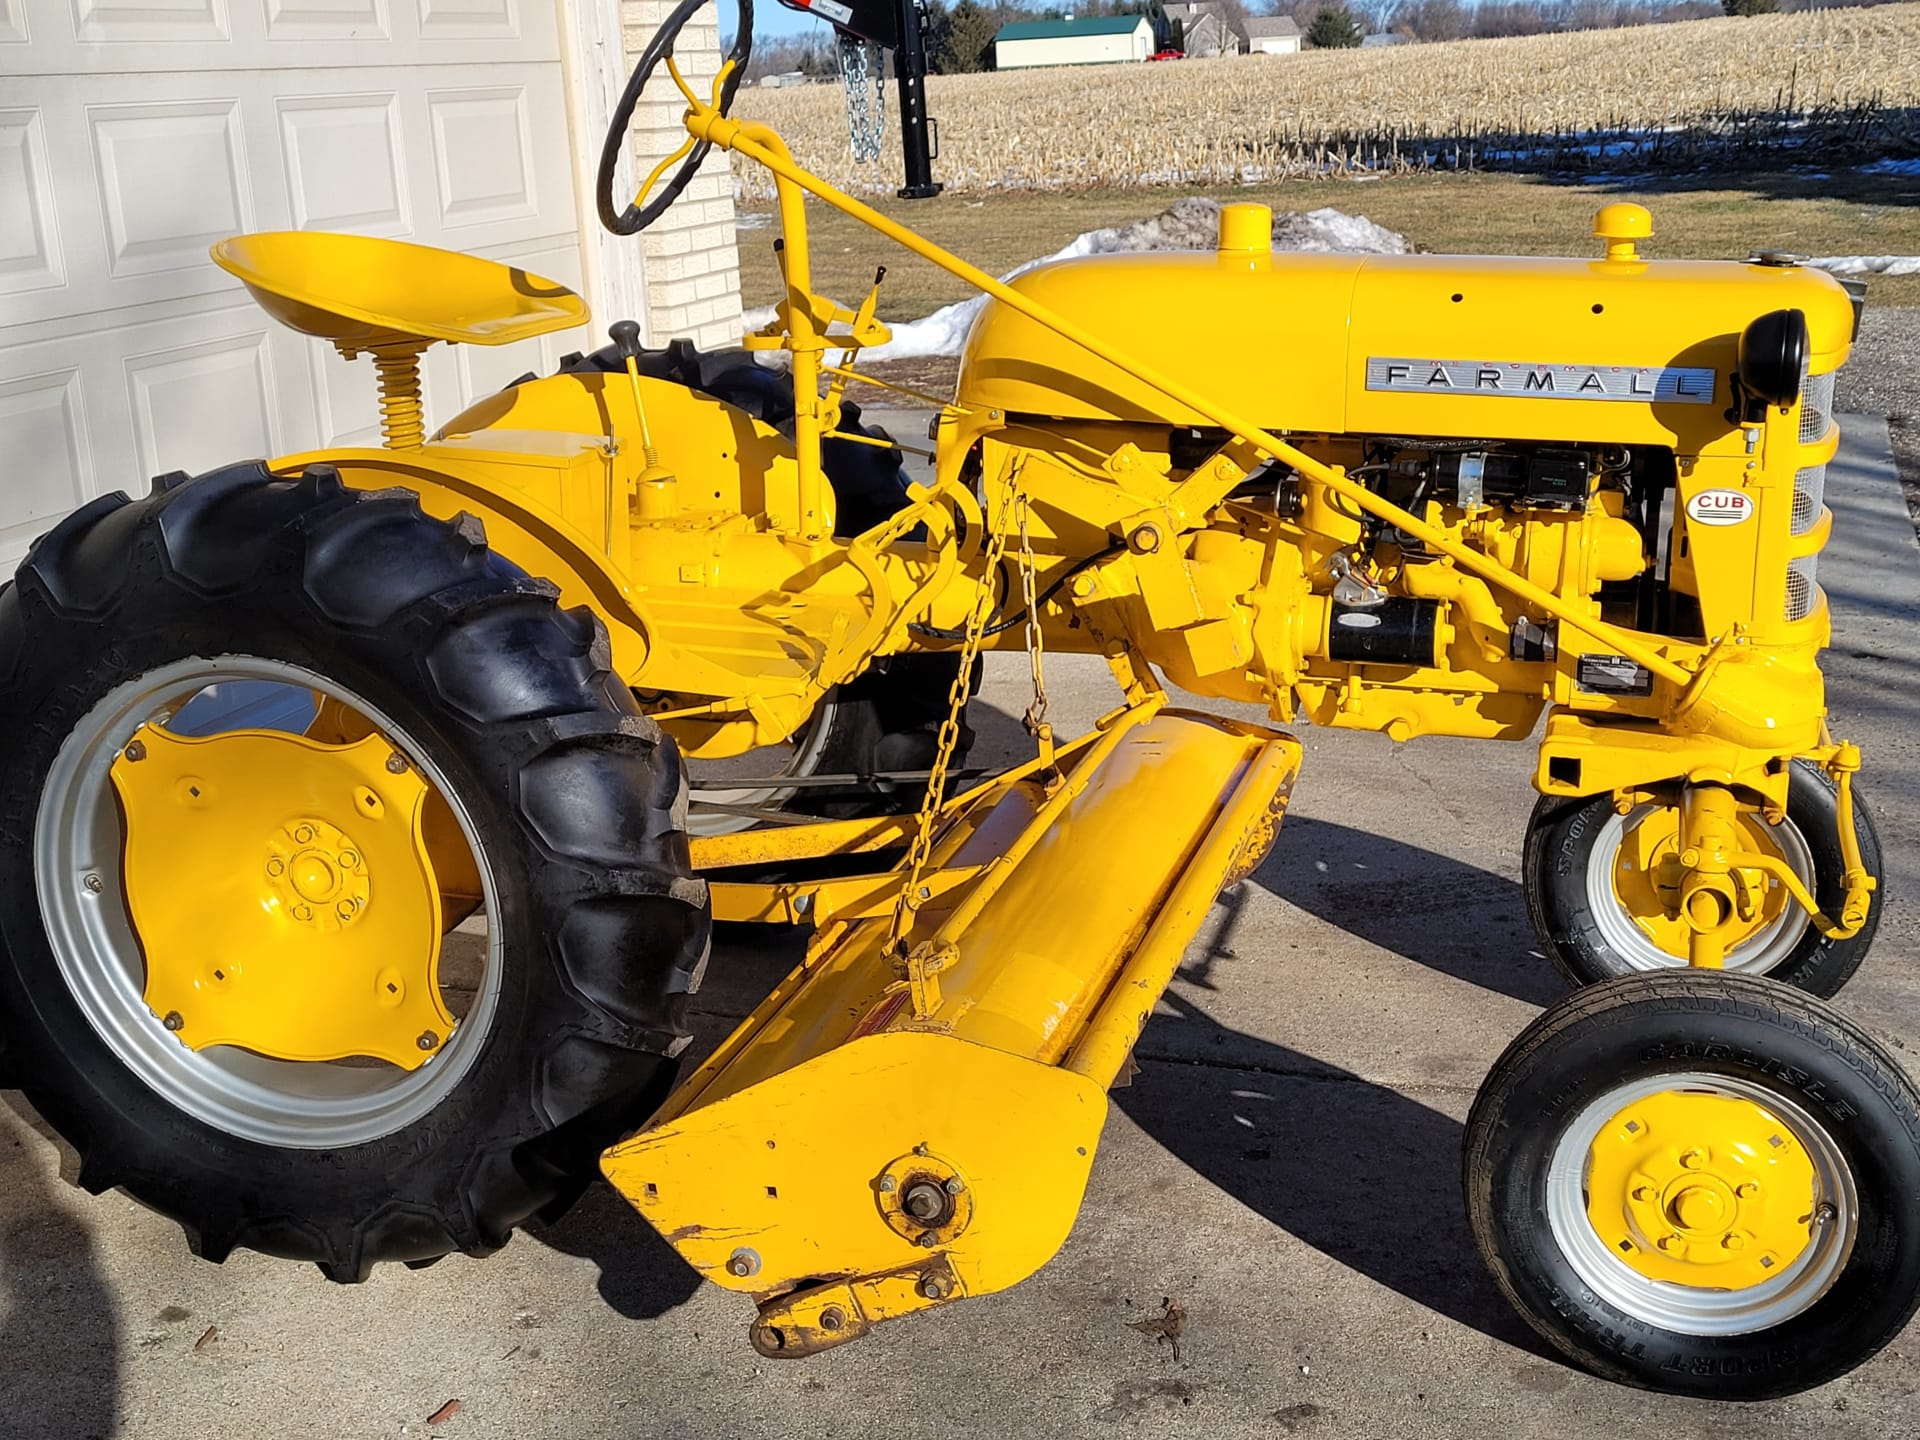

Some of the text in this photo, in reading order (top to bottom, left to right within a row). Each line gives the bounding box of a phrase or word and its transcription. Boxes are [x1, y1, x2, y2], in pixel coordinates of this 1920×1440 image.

[1386, 363, 1700, 397] FARMALL
[1697, 495, 1745, 509] CUB
[1640, 1038, 1858, 1121] CARLISLE
[1659, 1343, 1799, 1377] SPORT
